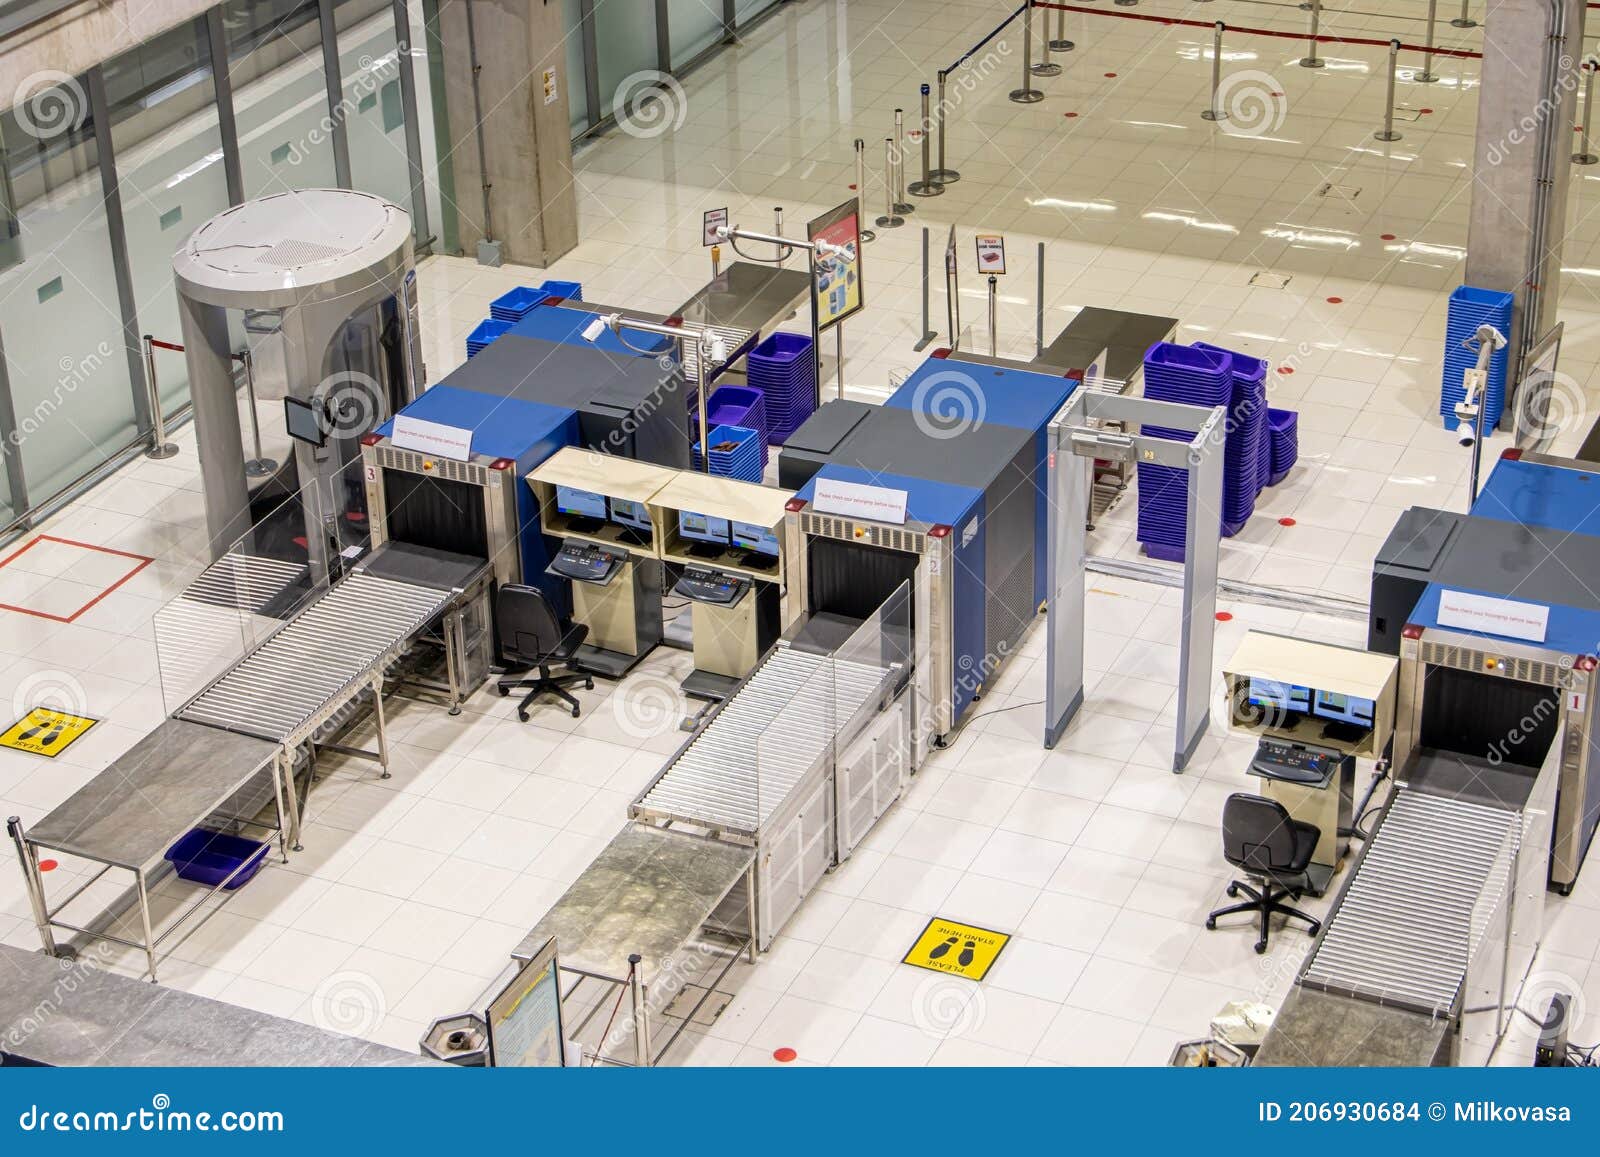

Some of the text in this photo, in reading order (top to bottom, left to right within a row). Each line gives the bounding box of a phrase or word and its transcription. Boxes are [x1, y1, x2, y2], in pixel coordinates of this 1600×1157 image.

[368, 468, 375, 480] 3
[930, 560, 937, 572] 2
[1572, 695, 1579, 710] 1
[938, 927, 996, 946] STAND HERE
[926, 960, 965, 973] PLEASE
